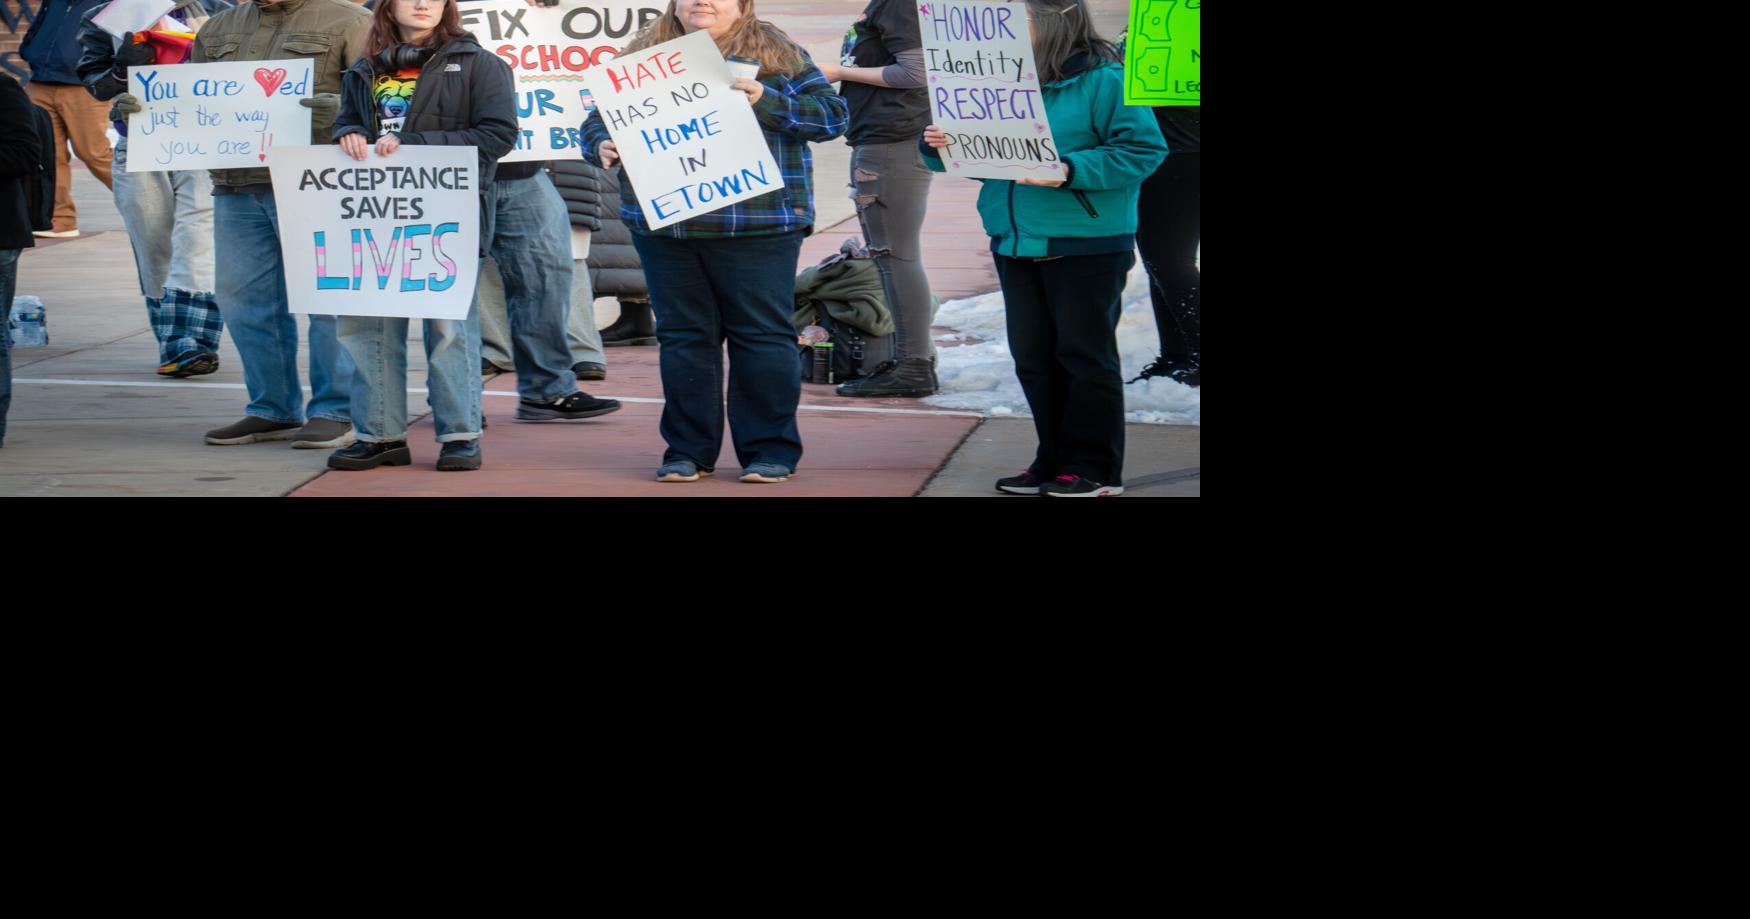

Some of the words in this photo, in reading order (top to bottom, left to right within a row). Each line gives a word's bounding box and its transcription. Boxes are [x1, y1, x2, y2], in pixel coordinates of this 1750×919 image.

[931, 3, 1016, 42] HONOR
[606, 51, 687, 94] HATE
[926, 48, 1024, 83] Identity
[135, 70, 179, 102] You
[192, 78, 245, 97] are
[935, 86, 1038, 121] RESPECT
[141, 107, 180, 136] just
[196, 104, 222, 127] the
[234, 109, 269, 133] way
[605, 96, 659, 131] HAS
[670, 82, 709, 106] NO
[641, 110, 722, 153] HOME
[943, 132, 1058, 163] PRONOUNS
[155, 139, 207, 165] you
[678, 147, 708, 176] IN
[299, 166, 469, 191] ACCEPTANCE
[650, 160, 771, 220] ETOWN
[340, 196, 424, 220] SAVES
[313, 222, 460, 293] LIVES
